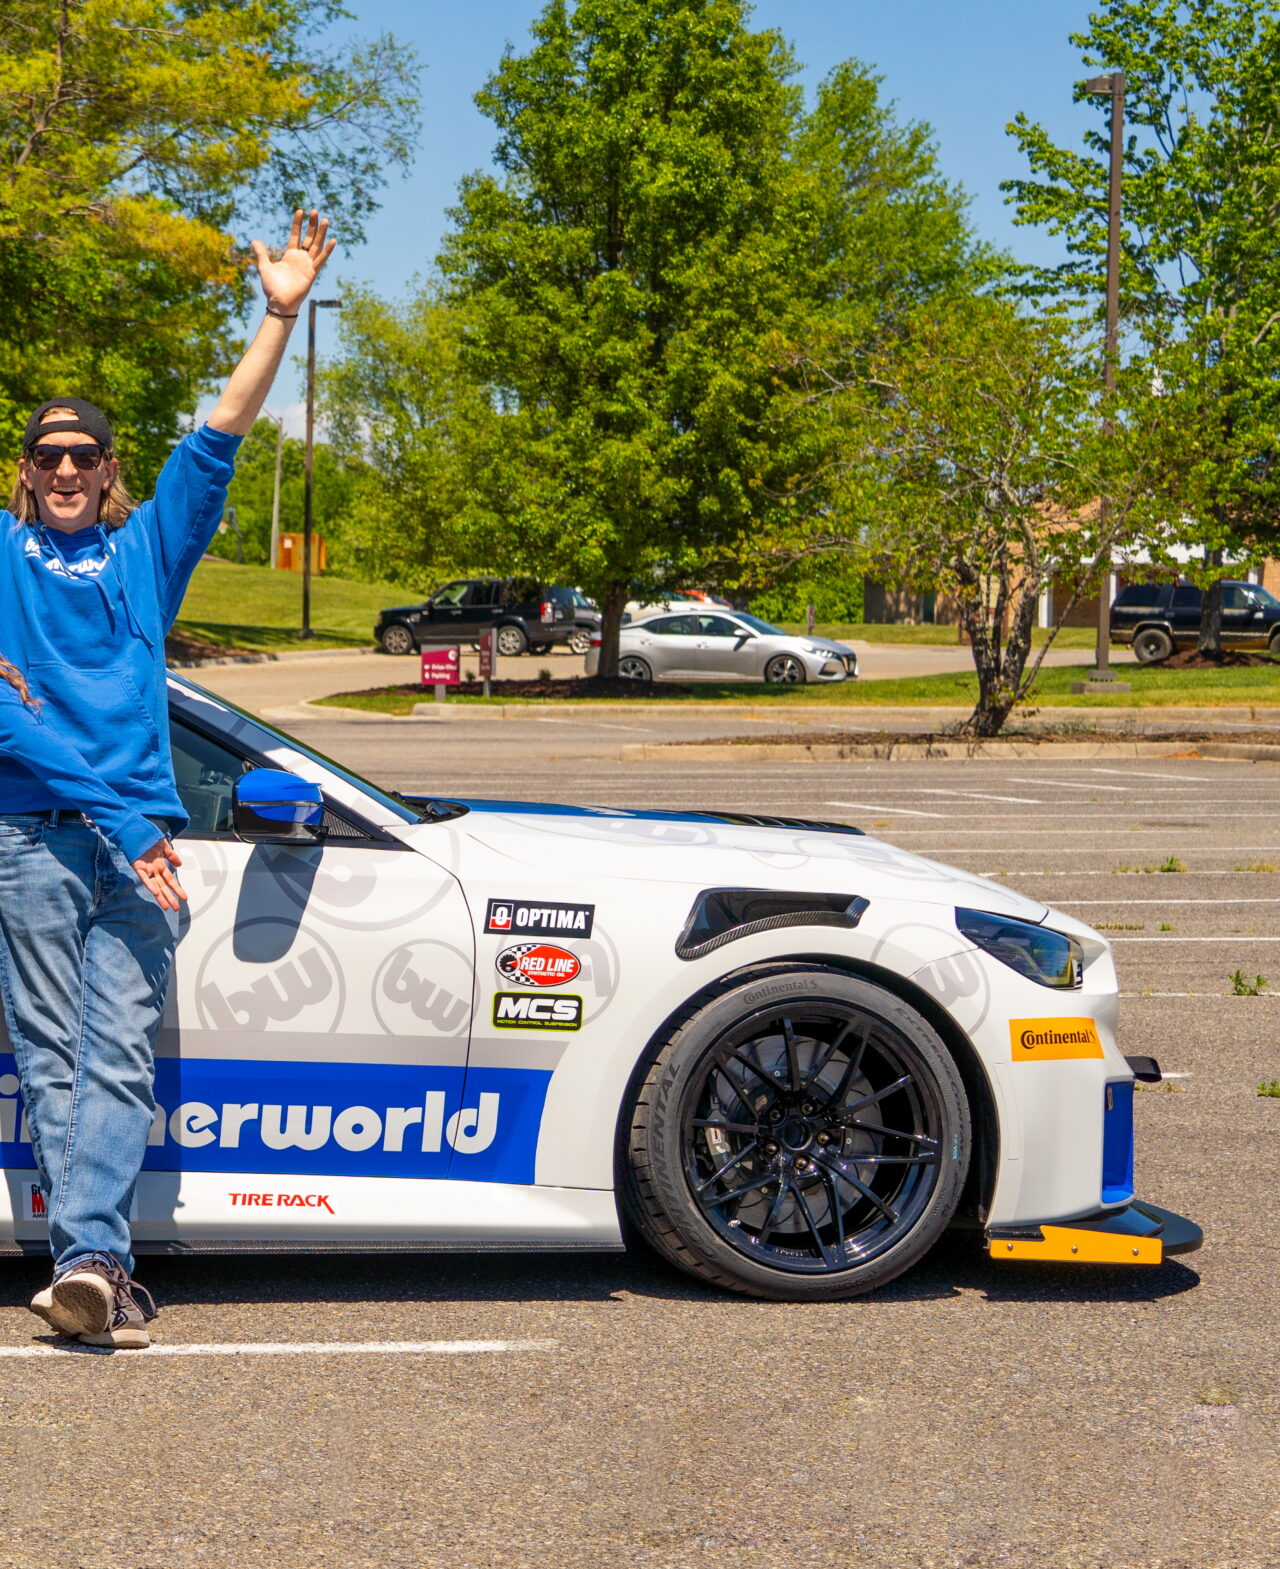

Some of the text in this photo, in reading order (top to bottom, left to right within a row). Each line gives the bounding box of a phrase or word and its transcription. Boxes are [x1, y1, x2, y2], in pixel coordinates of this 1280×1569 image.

[516, 908, 586, 930] OPTIMA
[521, 957, 575, 973] RED LINE
[744, 979, 809, 1005] Continental
[497, 997, 579, 1021] MCS
[1021, 1029, 1090, 1049] Continental
[228, 1193, 336, 1215] TIRE RACK
